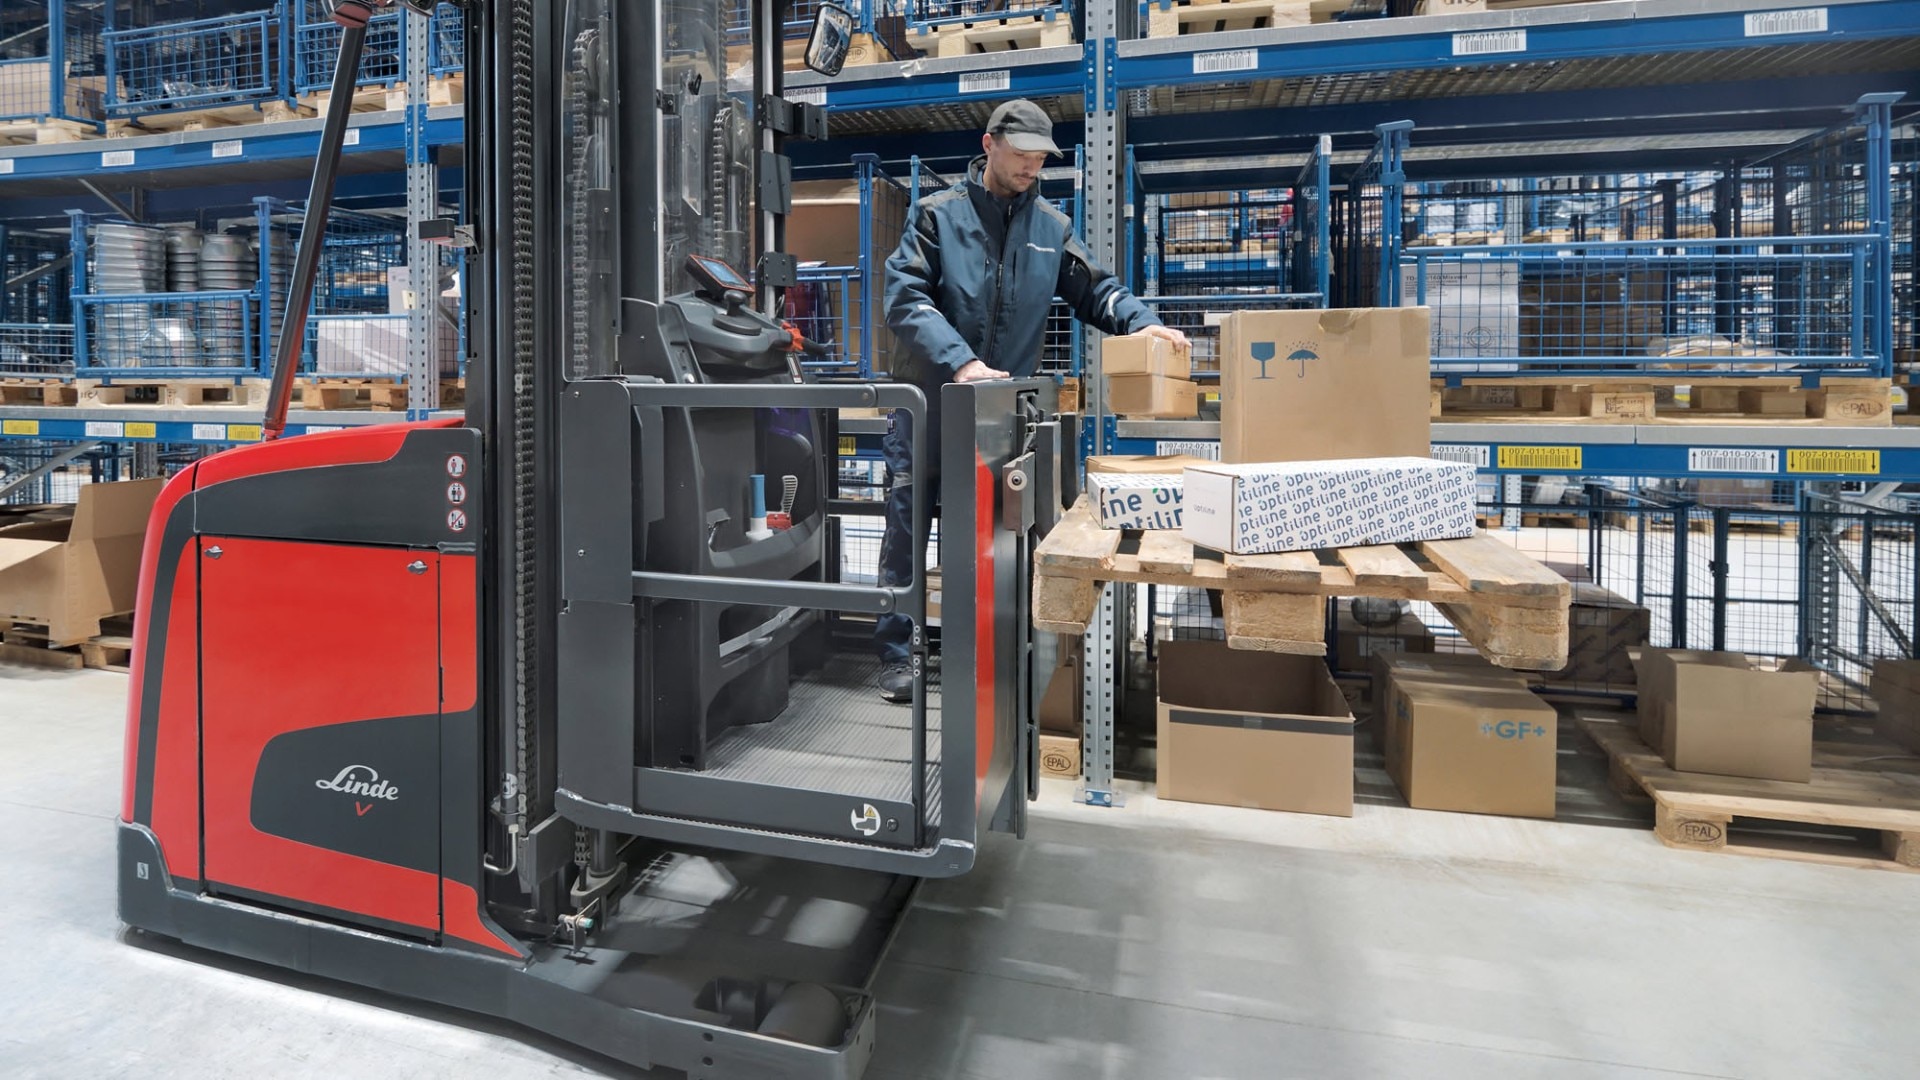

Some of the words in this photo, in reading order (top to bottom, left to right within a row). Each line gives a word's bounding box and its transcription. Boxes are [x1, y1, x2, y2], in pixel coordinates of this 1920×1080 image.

[1509, 447, 1570, 455] 007-011-01-1
[1701, 450, 1766, 458] 007-010-02-1
[1800, 451, 1866, 459] 007-010-01-1
[1239, 481, 1281, 503] tiline
[1240, 509, 1287, 535] ptiline
[1293, 488, 1346, 516] optiline
[1351, 468, 1403, 496] optiline
[1259, 485, 1314, 511] optiline
[1264, 512, 1321, 540] optiline
[1326, 491, 1378, 518] optiline
[1382, 472, 1433, 498] optiline
[1299, 514, 1353, 542] optiline
[1357, 494, 1409, 522] optiline
[1413, 475, 1462, 501] optiline
[1332, 518, 1385, 545] optiline
[1388, 497, 1439, 524] optiline
[1442, 484, 1475, 503] optili
[1419, 501, 1468, 527] optiline
[1046, 757, 1066, 769] EPAL
[315, 764, 399, 801] Linde
[1685, 824, 1713, 838] EPAL
